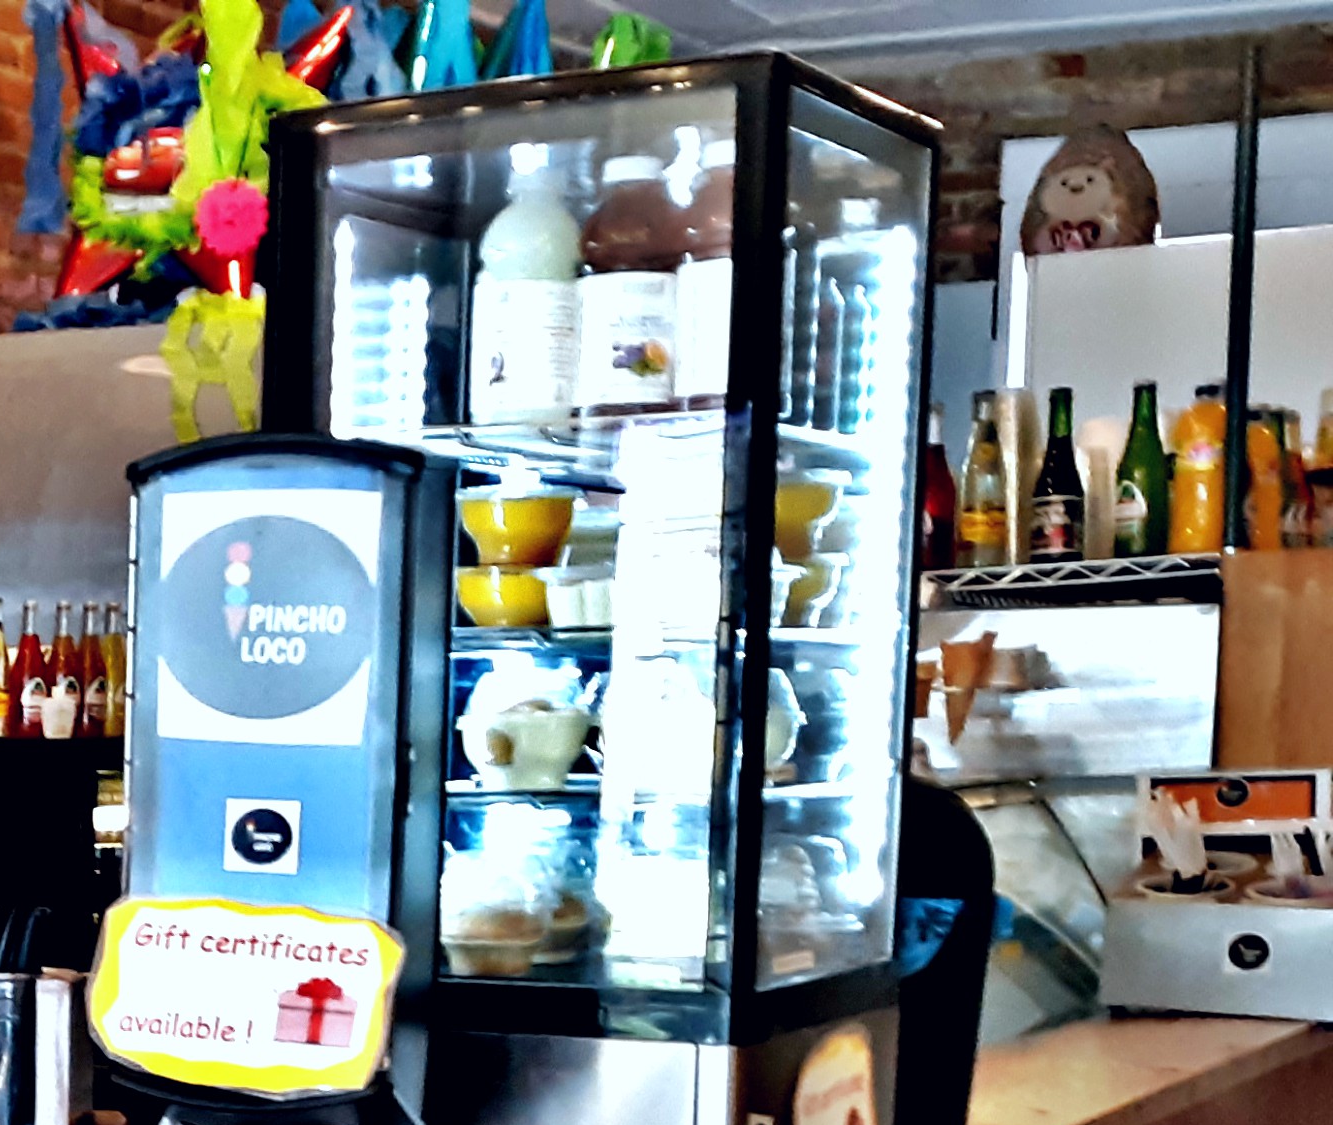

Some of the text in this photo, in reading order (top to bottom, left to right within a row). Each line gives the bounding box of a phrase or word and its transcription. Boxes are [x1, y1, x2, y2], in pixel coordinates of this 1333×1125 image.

[248, 603, 347, 634] PINCHO
[240, 636, 307, 666] LOCO
[134, 922, 370, 967] Gift certificates
[119, 1012, 236, 1043] available
